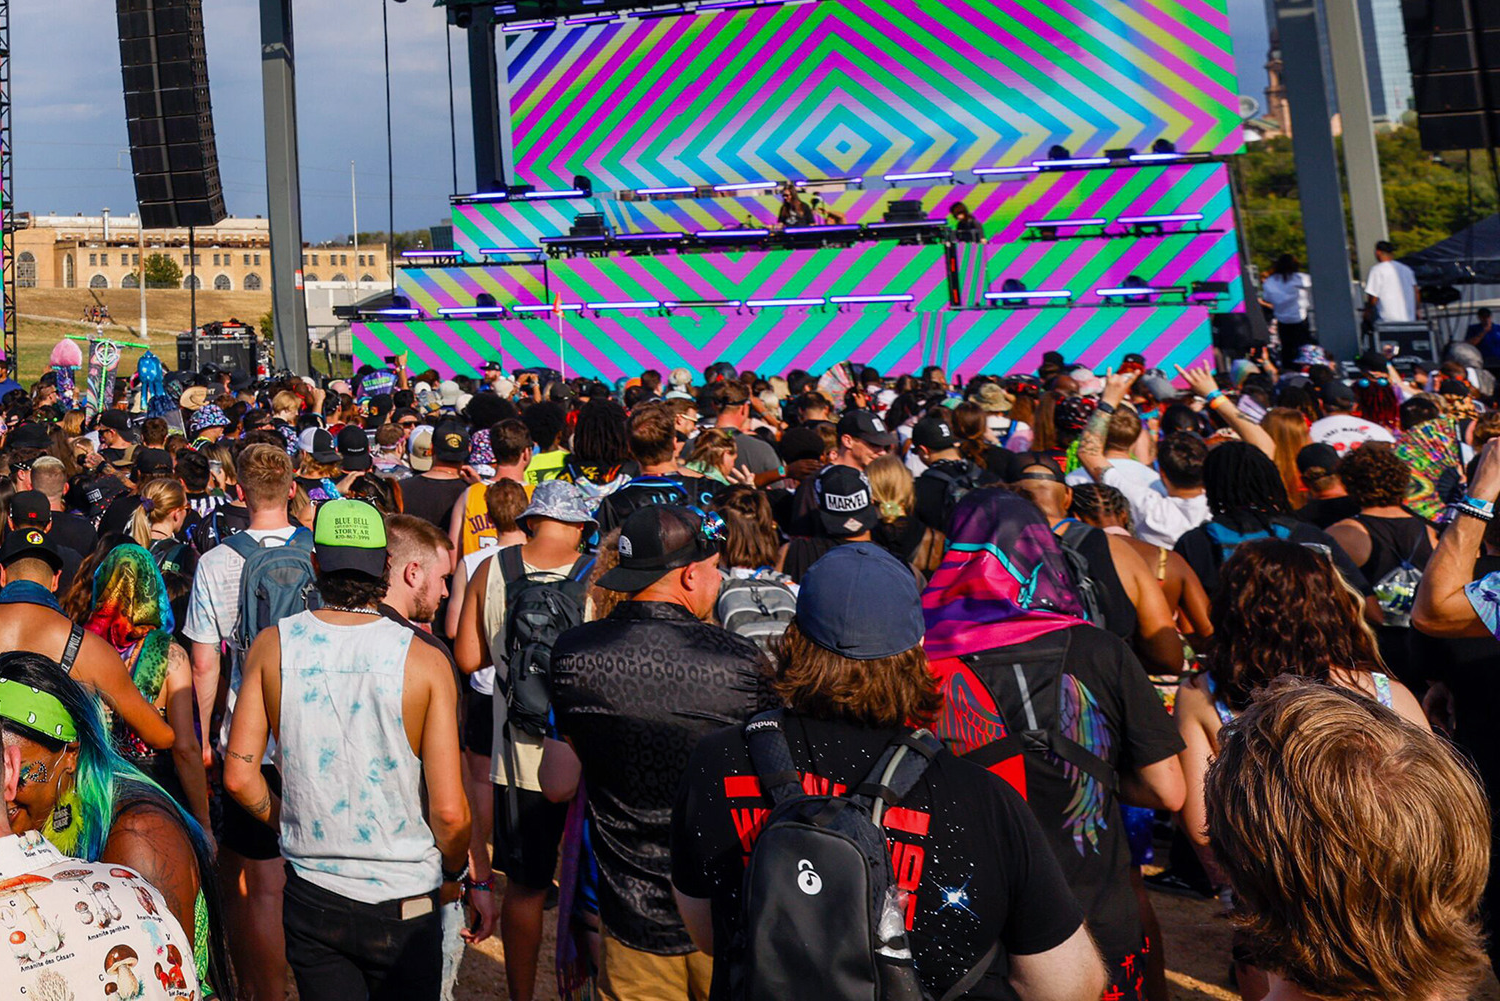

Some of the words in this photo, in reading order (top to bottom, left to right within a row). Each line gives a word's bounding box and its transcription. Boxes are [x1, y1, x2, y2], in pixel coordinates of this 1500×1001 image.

[827, 493, 866, 510] MARVEL
[334, 517, 350, 525] BLUE
[353, 517, 369, 526] BELL
[20, 962, 44, 973] Amanite
